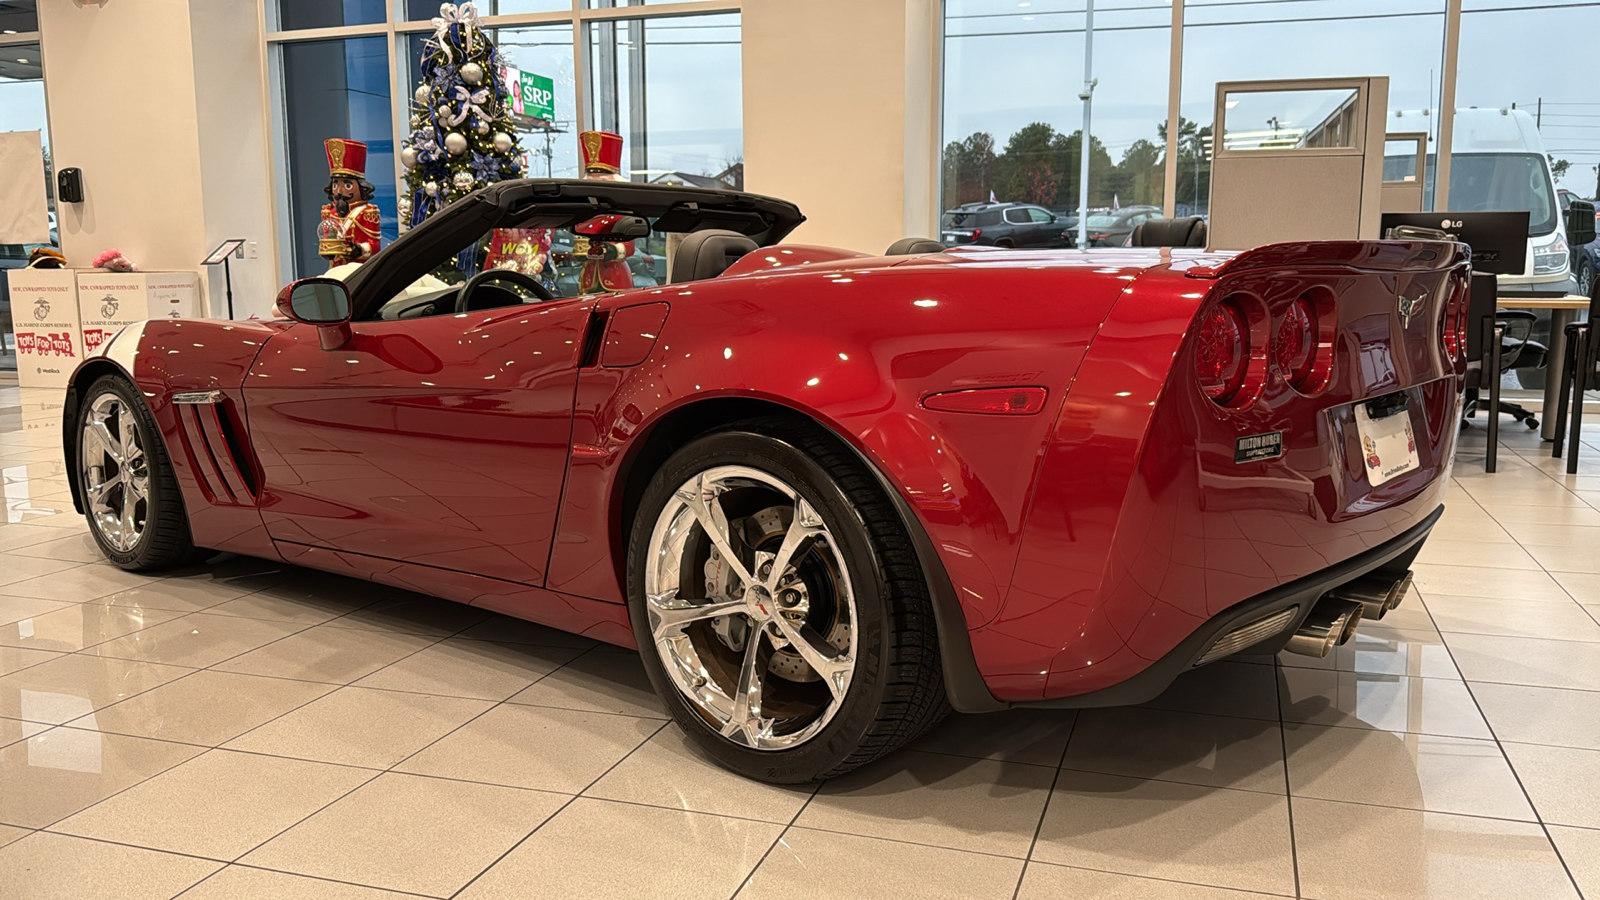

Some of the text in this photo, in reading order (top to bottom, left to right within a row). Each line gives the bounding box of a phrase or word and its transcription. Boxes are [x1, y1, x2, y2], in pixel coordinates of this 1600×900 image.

[523, 85, 552, 105] SRP
[1451, 220, 1463, 228] LG
[18, 335, 70, 352] TOYS FOR TOTS
[85, 331, 102, 345] TOYS
[1239, 437, 1261, 450] MILTON
